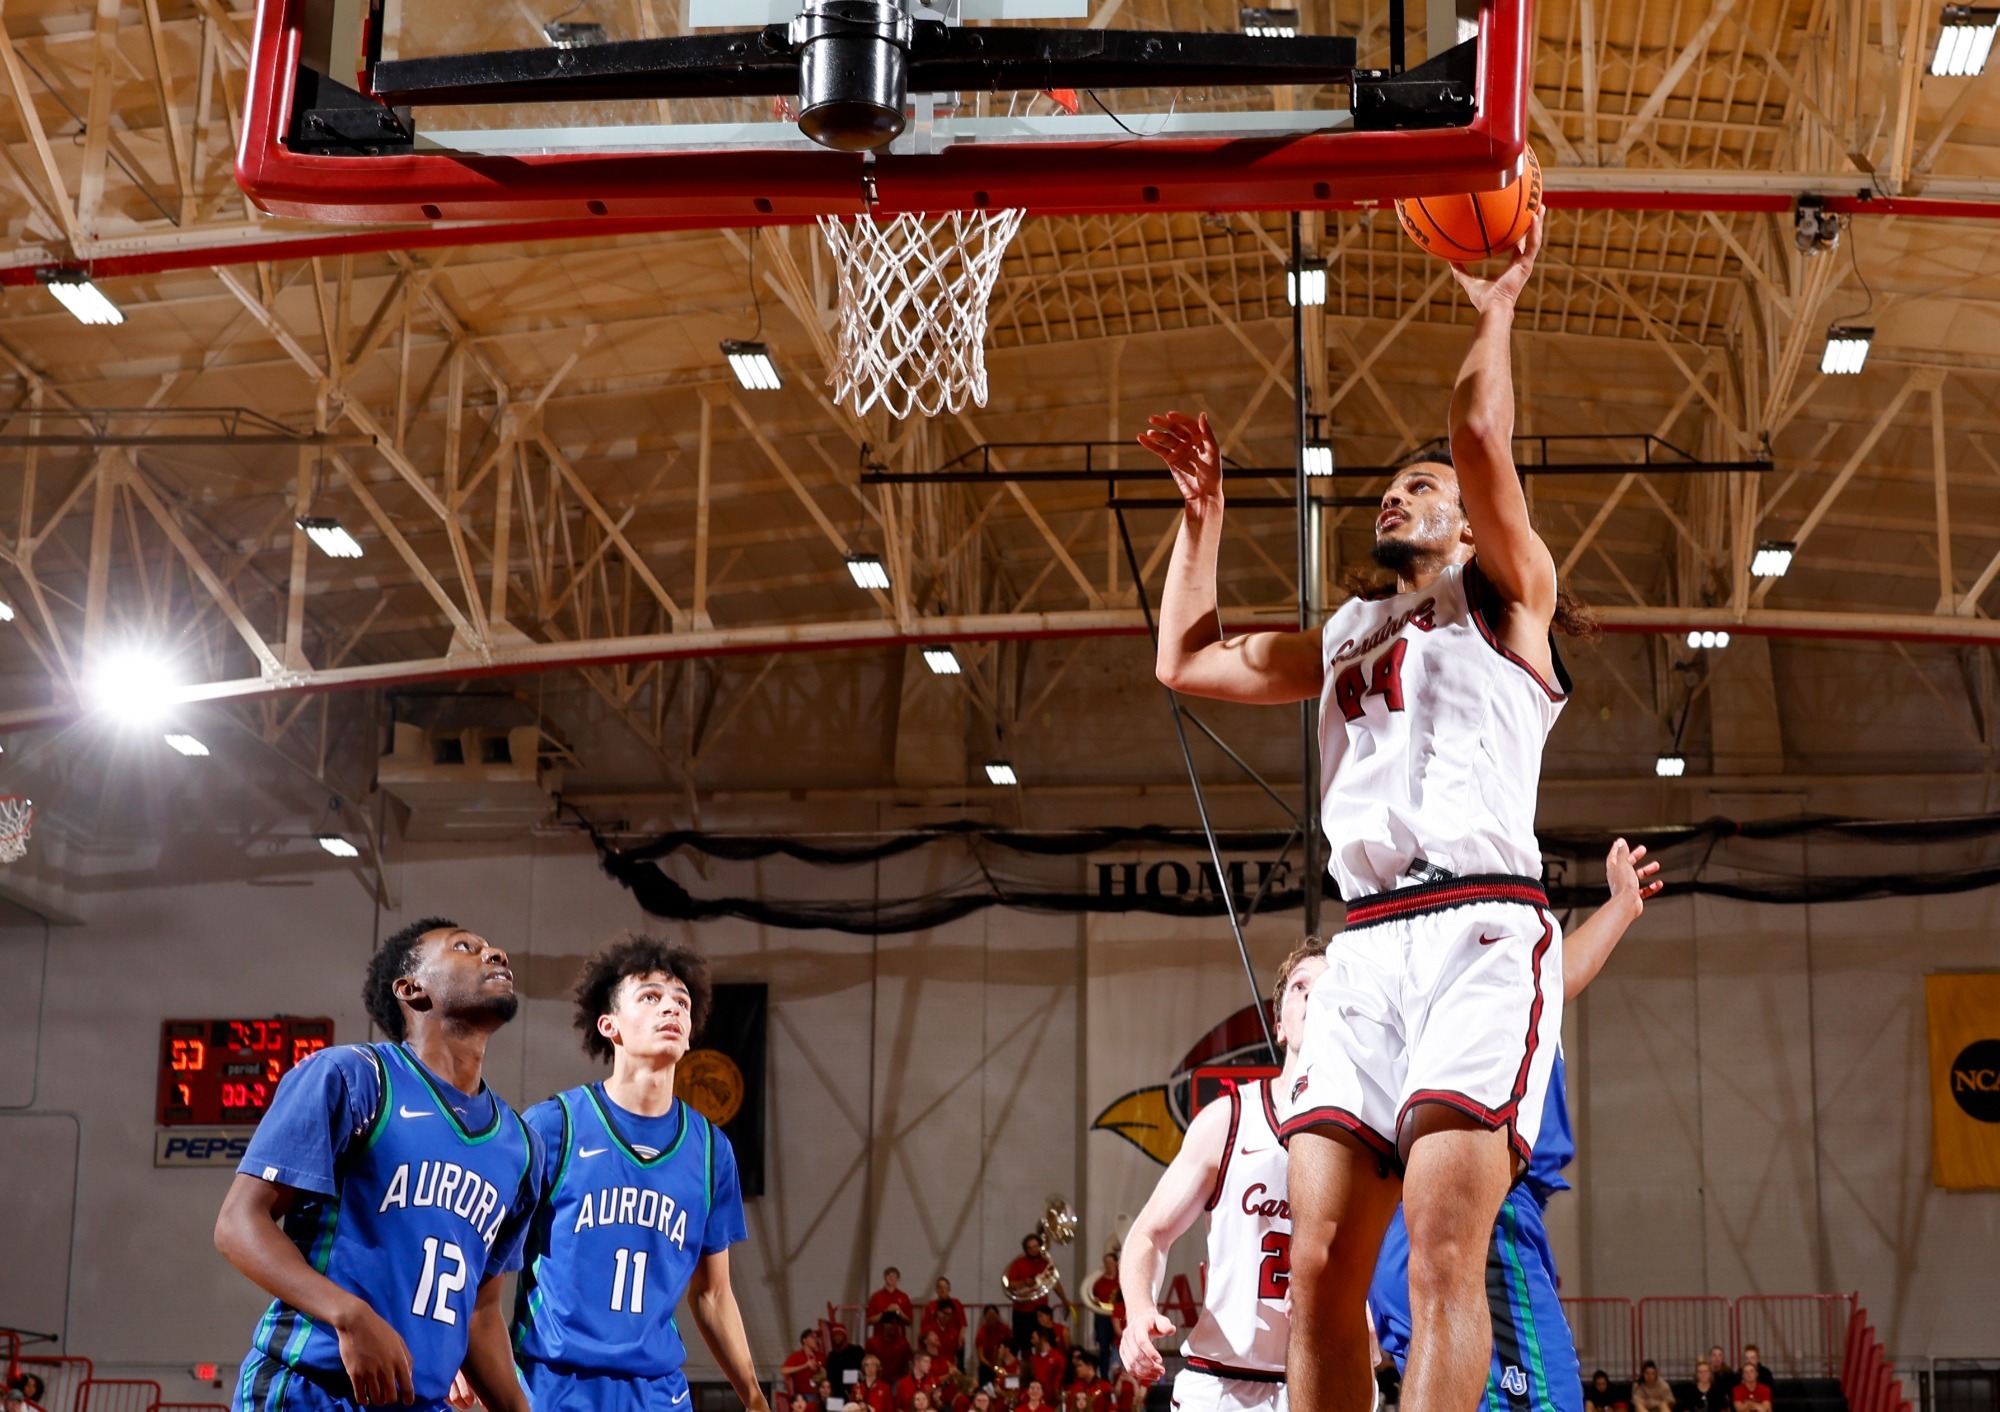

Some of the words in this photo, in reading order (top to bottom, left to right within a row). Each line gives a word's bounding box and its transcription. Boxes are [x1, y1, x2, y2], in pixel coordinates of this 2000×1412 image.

[164, 1137, 251, 1160] PEPS
[378, 1160, 507, 1253] AURORA
[573, 1186, 688, 1252] AURORA
[411, 1236, 467, 1326] 12
[610, 1247, 648, 1314] 11
